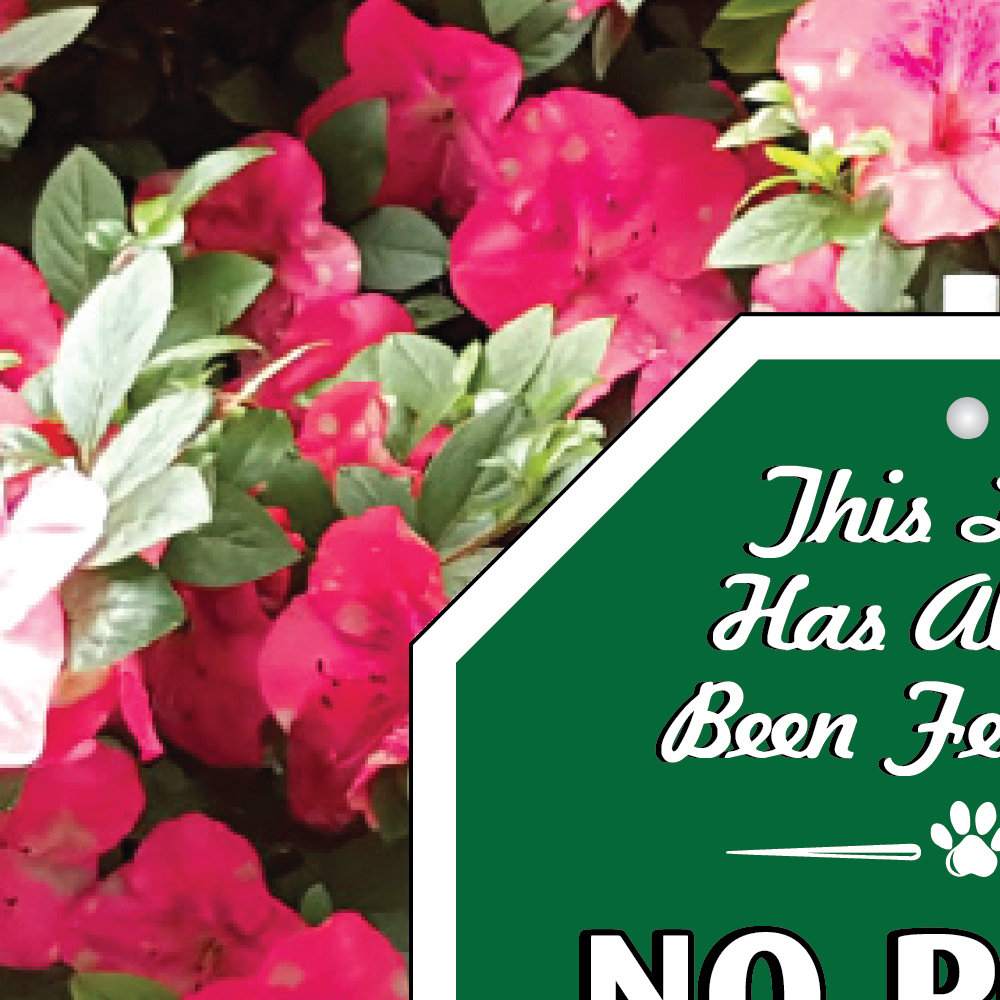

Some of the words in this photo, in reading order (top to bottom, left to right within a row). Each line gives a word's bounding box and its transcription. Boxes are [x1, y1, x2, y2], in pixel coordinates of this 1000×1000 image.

[744, 465, 932, 559] This
[707, 573, 886, 651] Has
[656, 681, 858, 763] Been
